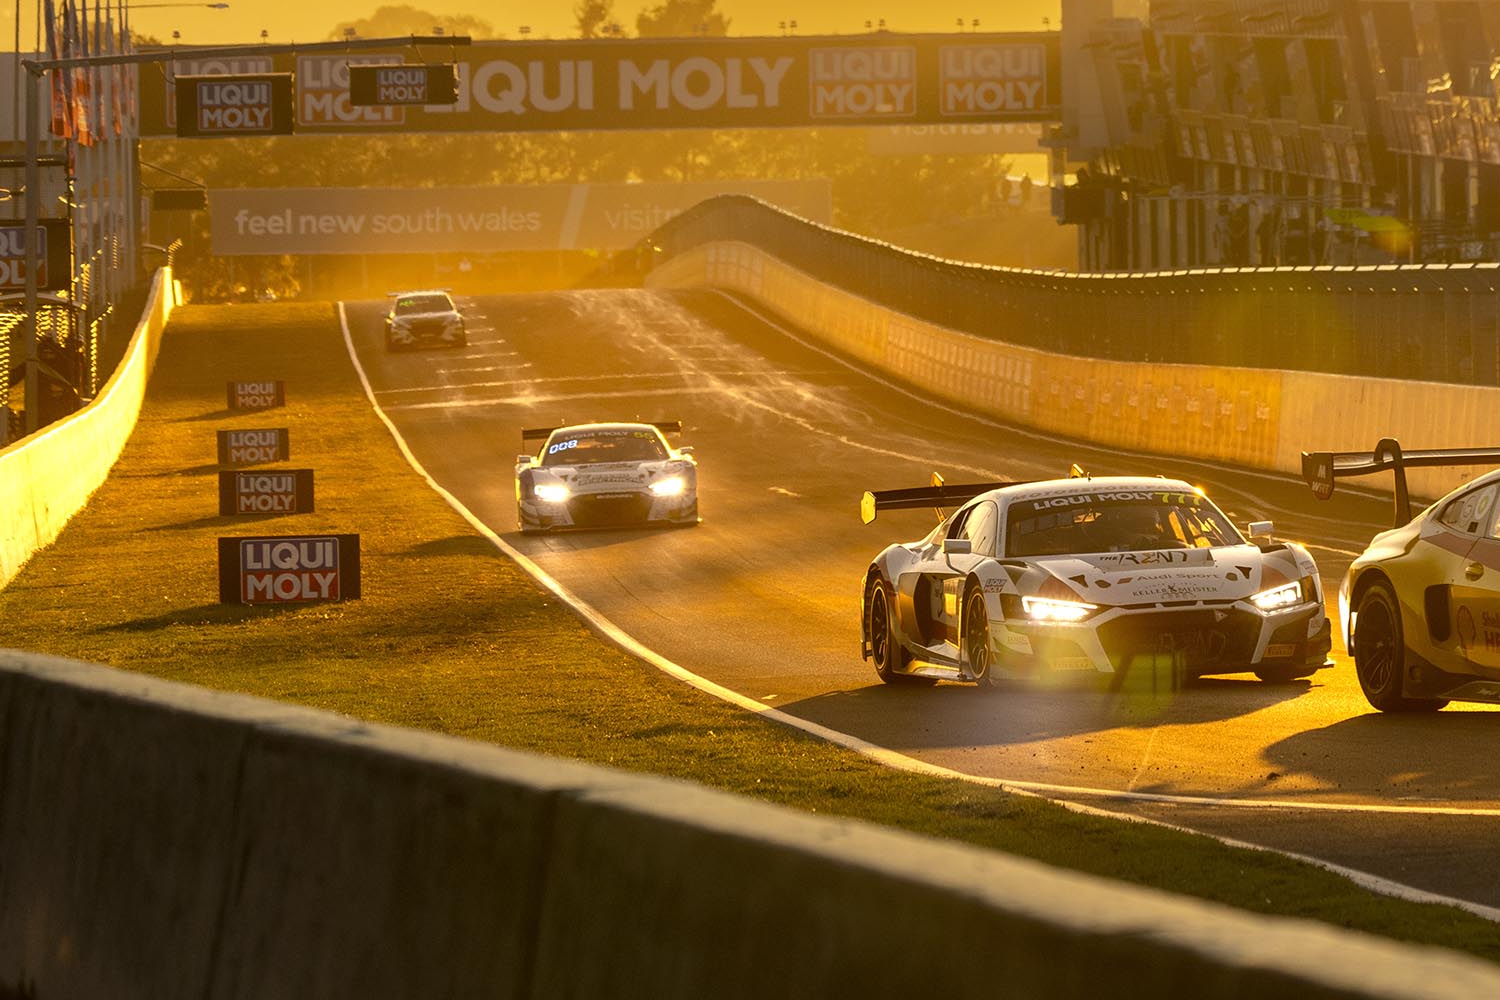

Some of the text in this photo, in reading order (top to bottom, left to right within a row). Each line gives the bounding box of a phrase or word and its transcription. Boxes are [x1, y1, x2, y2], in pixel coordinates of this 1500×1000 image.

[815, 51, 912, 81] LIQUI
[945, 48, 1040, 79] LIQUI
[380, 70, 425, 86] LIQUI
[424, 57, 794, 114] IQUI MOLY
[202, 84, 268, 105] LIQUI
[380, 86, 425, 101] MOLY
[816, 83, 912, 113] MOLY
[945, 80, 1042, 111] MOLY
[203, 107, 270, 128] MOLY
[234, 206, 541, 235] feel new south wales
[237, 383, 274, 394] LIQUI
[238, 396, 274, 407] MOLY
[230, 432, 276, 446] LIQUI
[549, 440, 578, 455] 008
[231, 448, 276, 462] MOLY
[239, 476, 293, 493] LIQUI
[240, 495, 294, 512] MOLY
[1033, 491, 1202, 510] LIQUI MOLY 777
[246, 541, 334, 570] LIQUI
[247, 572, 336, 600] MOLY
